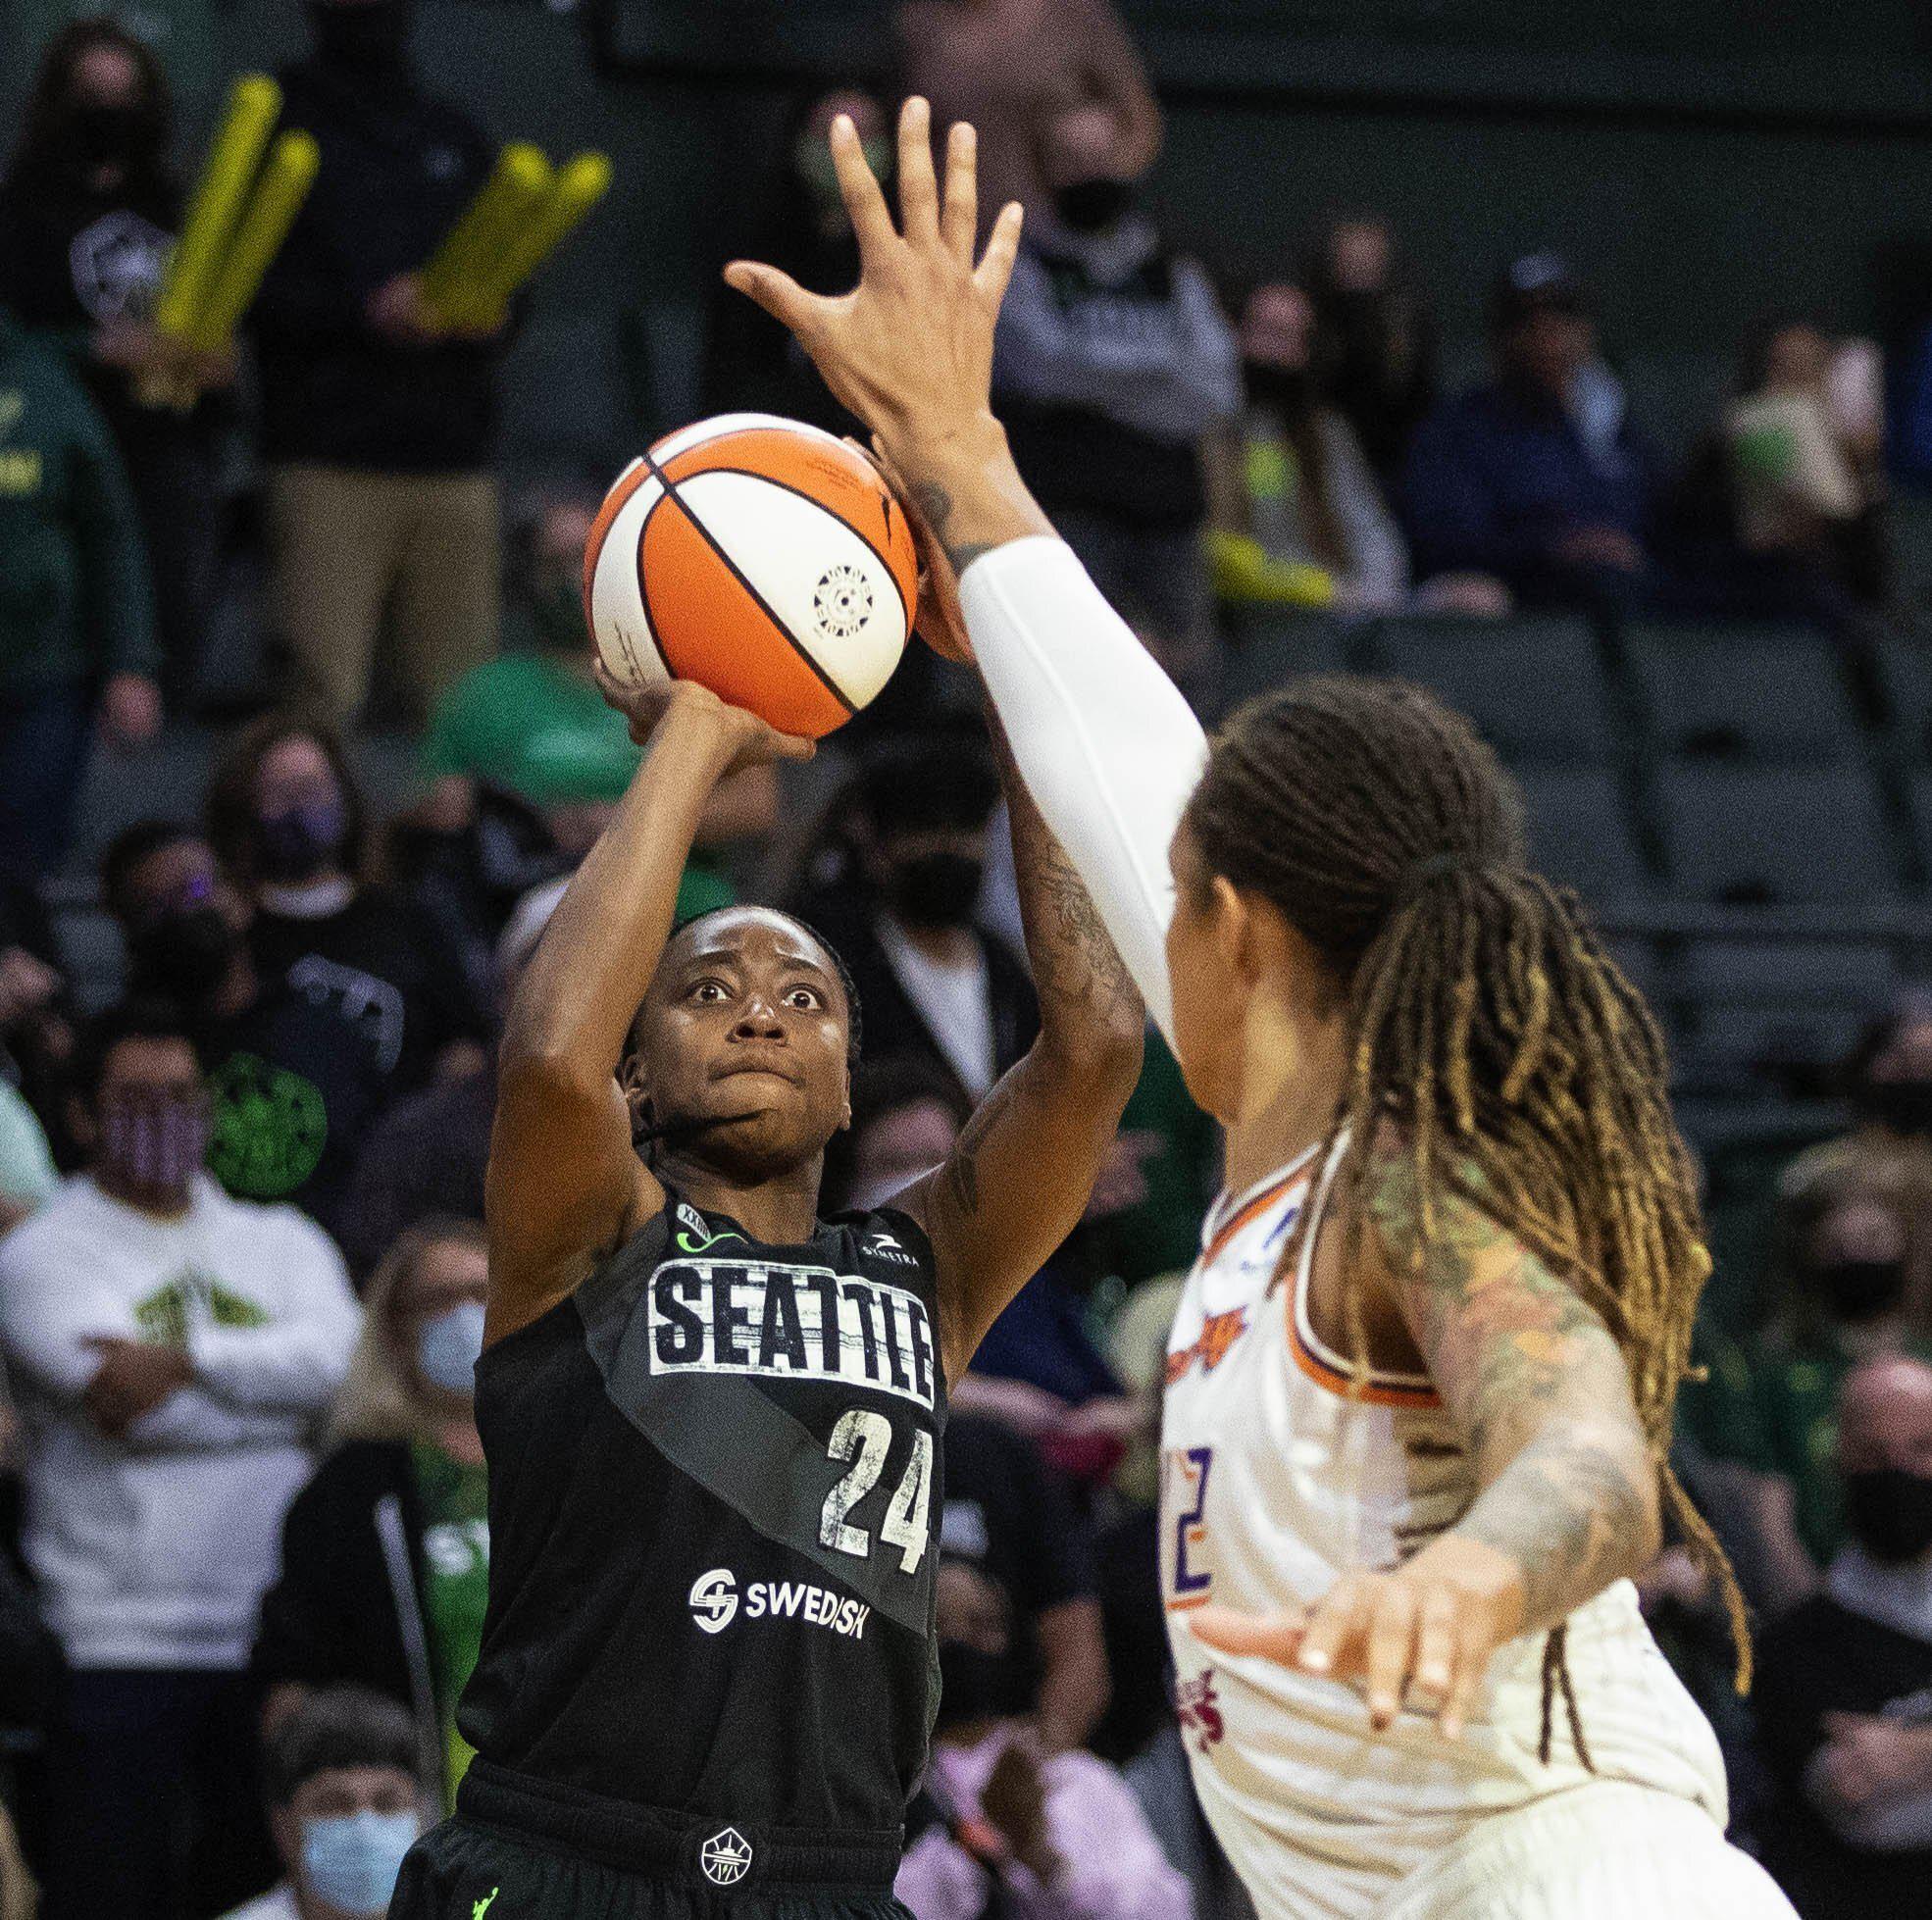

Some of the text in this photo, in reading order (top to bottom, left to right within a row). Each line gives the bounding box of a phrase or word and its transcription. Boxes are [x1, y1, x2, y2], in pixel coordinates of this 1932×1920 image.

[652, 1264, 934, 1404] SEATTLE
[819, 1409, 934, 1575] 24
[745, 1581, 870, 1640] SWEDISH
